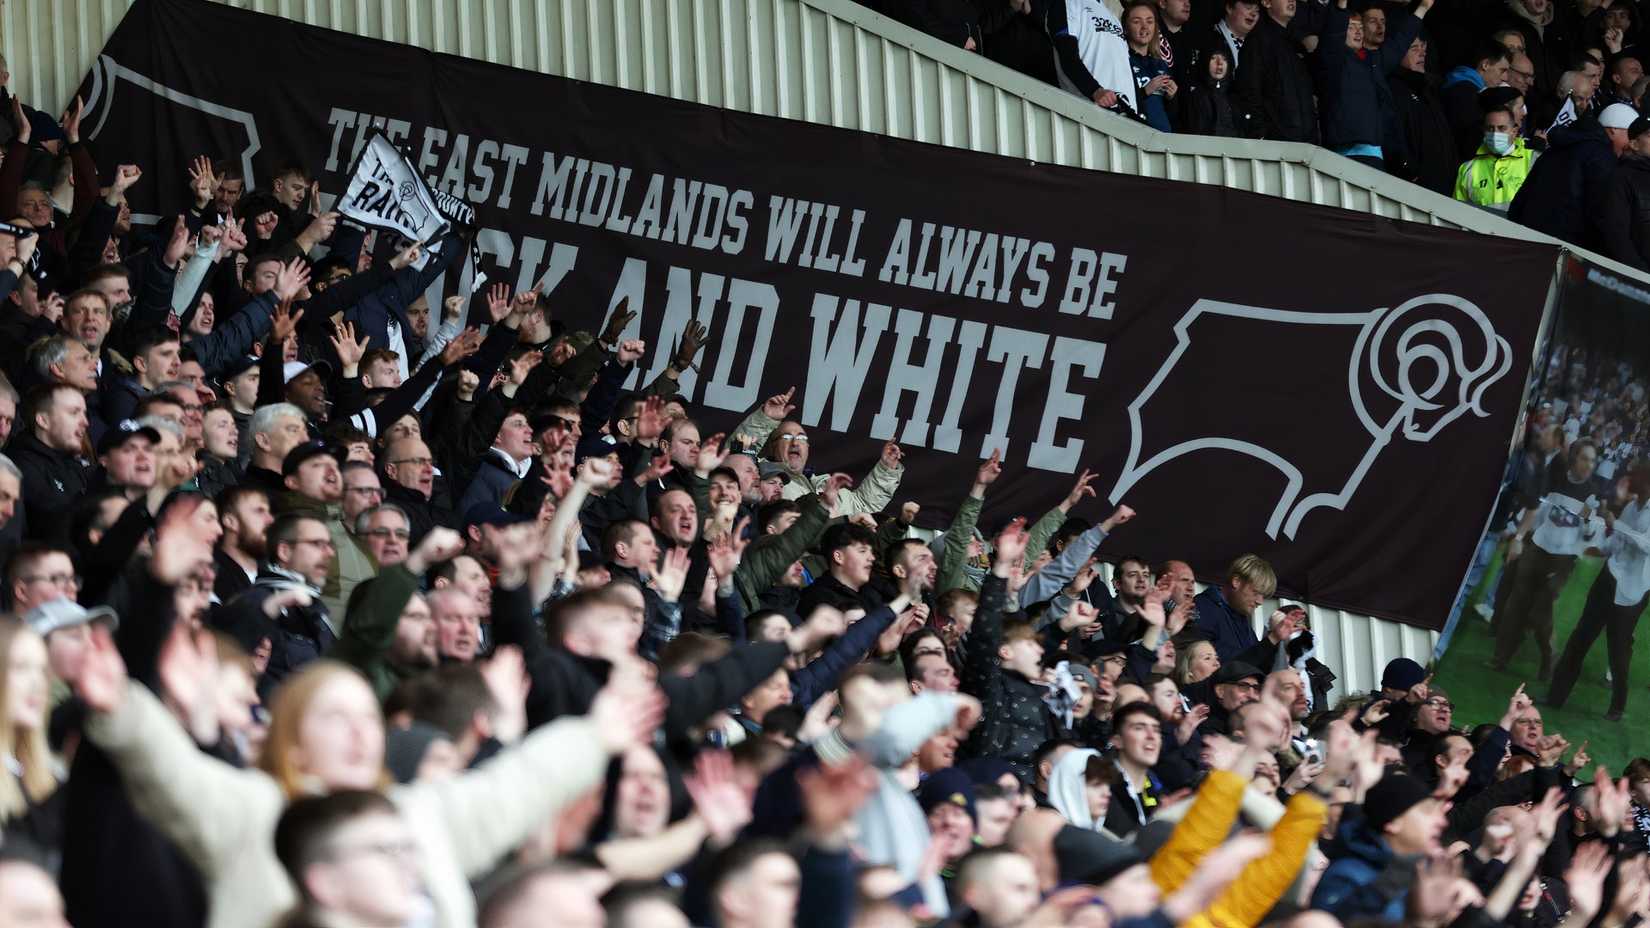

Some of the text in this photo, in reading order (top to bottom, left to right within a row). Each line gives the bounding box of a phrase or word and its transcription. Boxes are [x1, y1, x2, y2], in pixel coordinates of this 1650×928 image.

[418, 126, 528, 208] EAST
[531, 151, 754, 255] MIDLANDS
[764, 195, 866, 278] WILL
[879, 218, 1056, 309] ALWAYS
[1059, 247, 1128, 320] BE
[600, 257, 780, 413] AND
[802, 292, 1107, 474] WHITE
